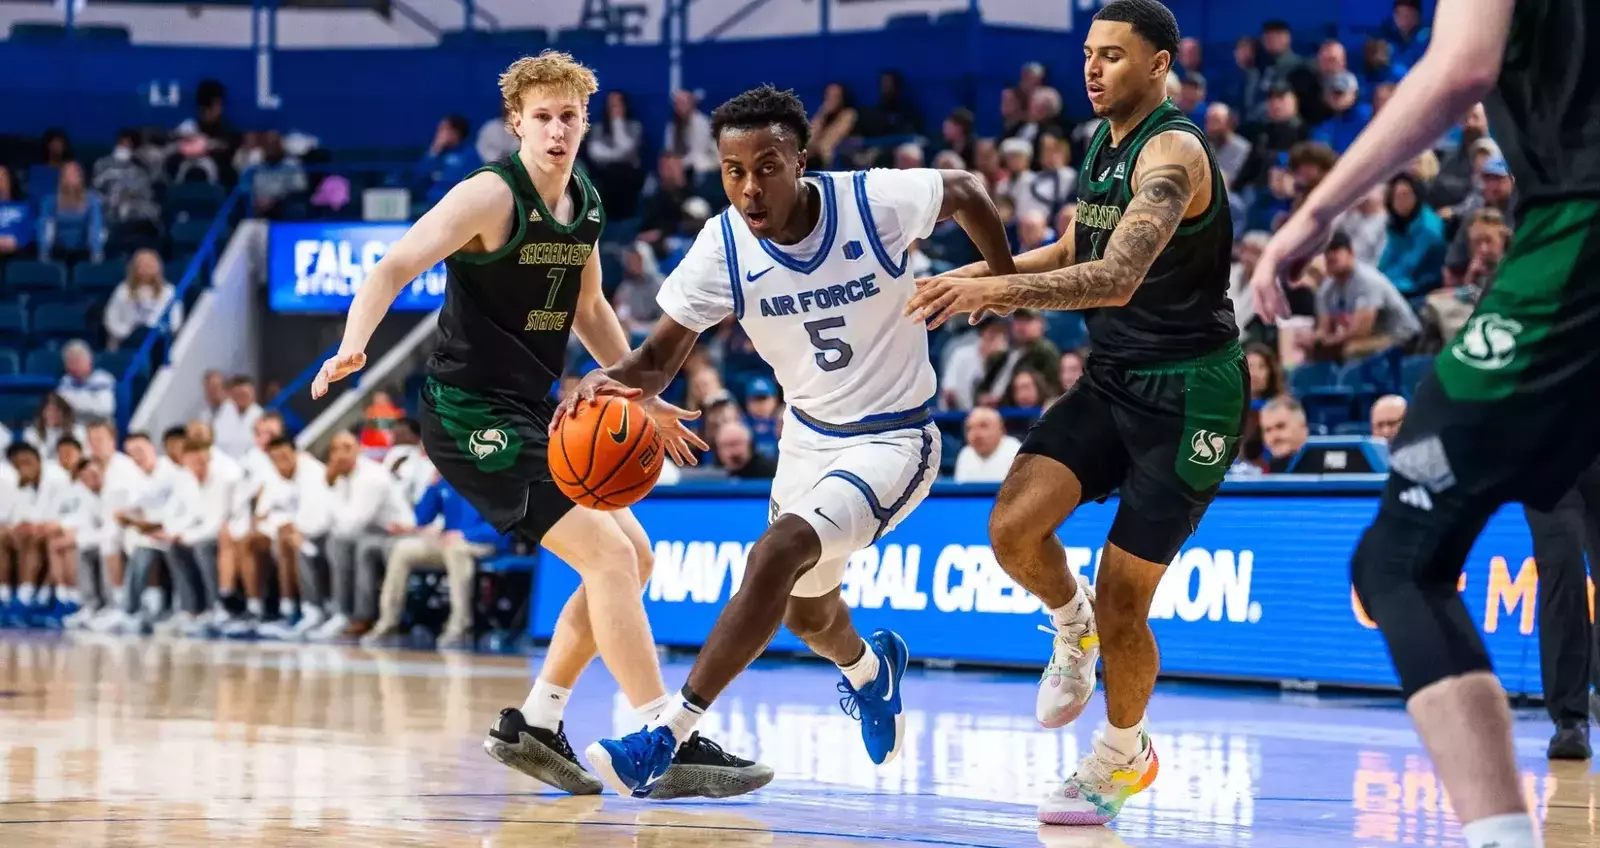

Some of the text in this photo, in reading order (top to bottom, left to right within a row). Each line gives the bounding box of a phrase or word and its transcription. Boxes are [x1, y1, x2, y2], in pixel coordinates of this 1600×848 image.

[545, 267, 566, 309] 7
[760, 273, 881, 317] AIR FORCE
[524, 309, 568, 331] STATE
[803, 315, 853, 372] 5
